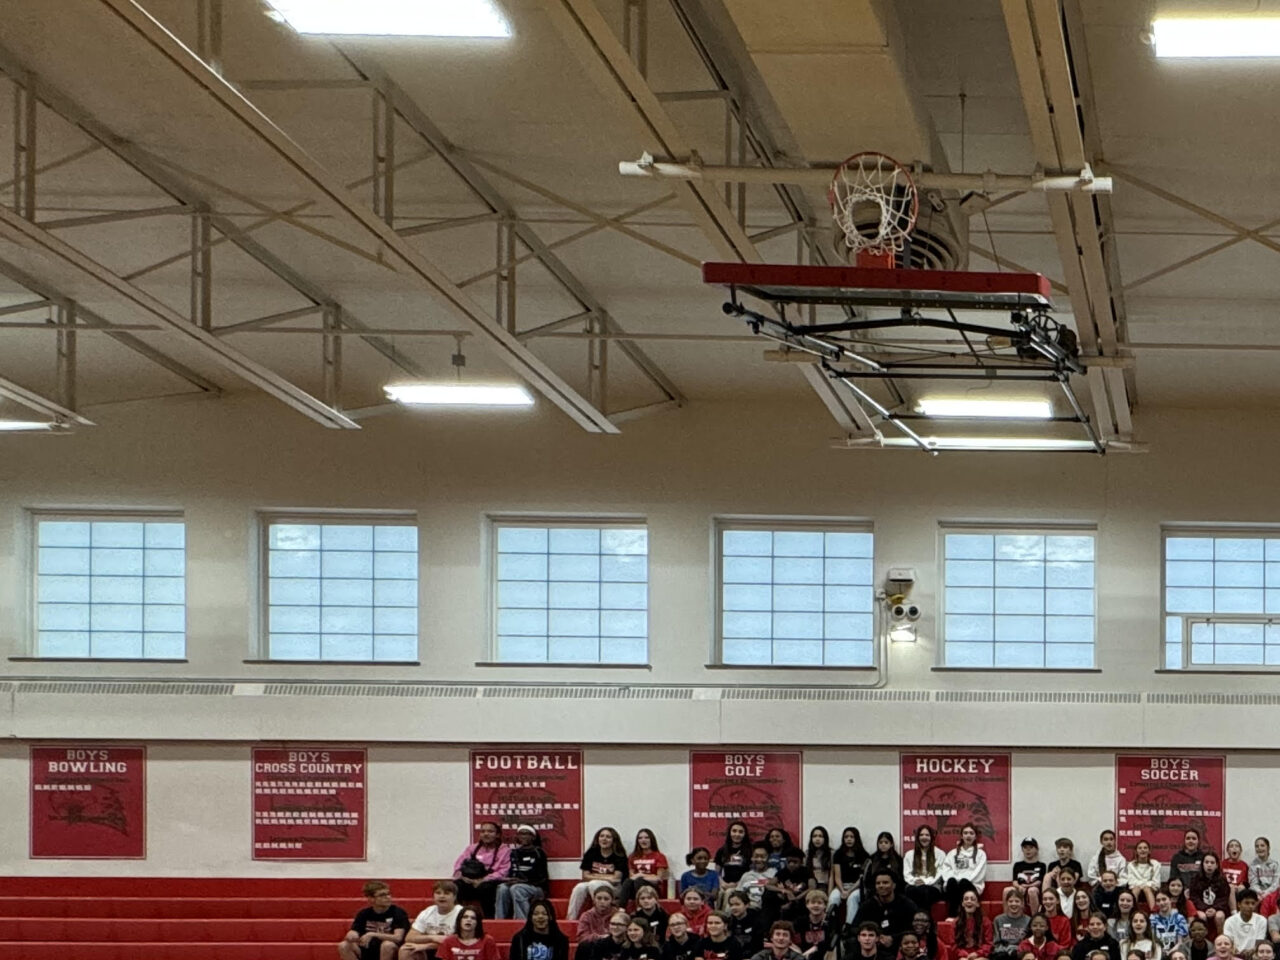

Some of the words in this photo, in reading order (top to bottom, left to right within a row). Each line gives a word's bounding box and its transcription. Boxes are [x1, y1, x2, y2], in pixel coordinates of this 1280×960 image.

[67, 750, 108, 760] BOYS
[288, 752, 330, 762] BOYS
[725, 755, 765, 765] BOYS
[48, 761, 127, 773] BOWLING
[475, 755, 578, 769] FOOTBALL
[916, 758, 995, 773] HOCKEY
[1151, 759, 1190, 769] BOYS
[255, 763, 296, 773] CROSS
[300, 763, 362, 774] COUNTRY
[725, 766, 764, 776] GOLF
[1141, 769, 1199, 780] SOCCER
